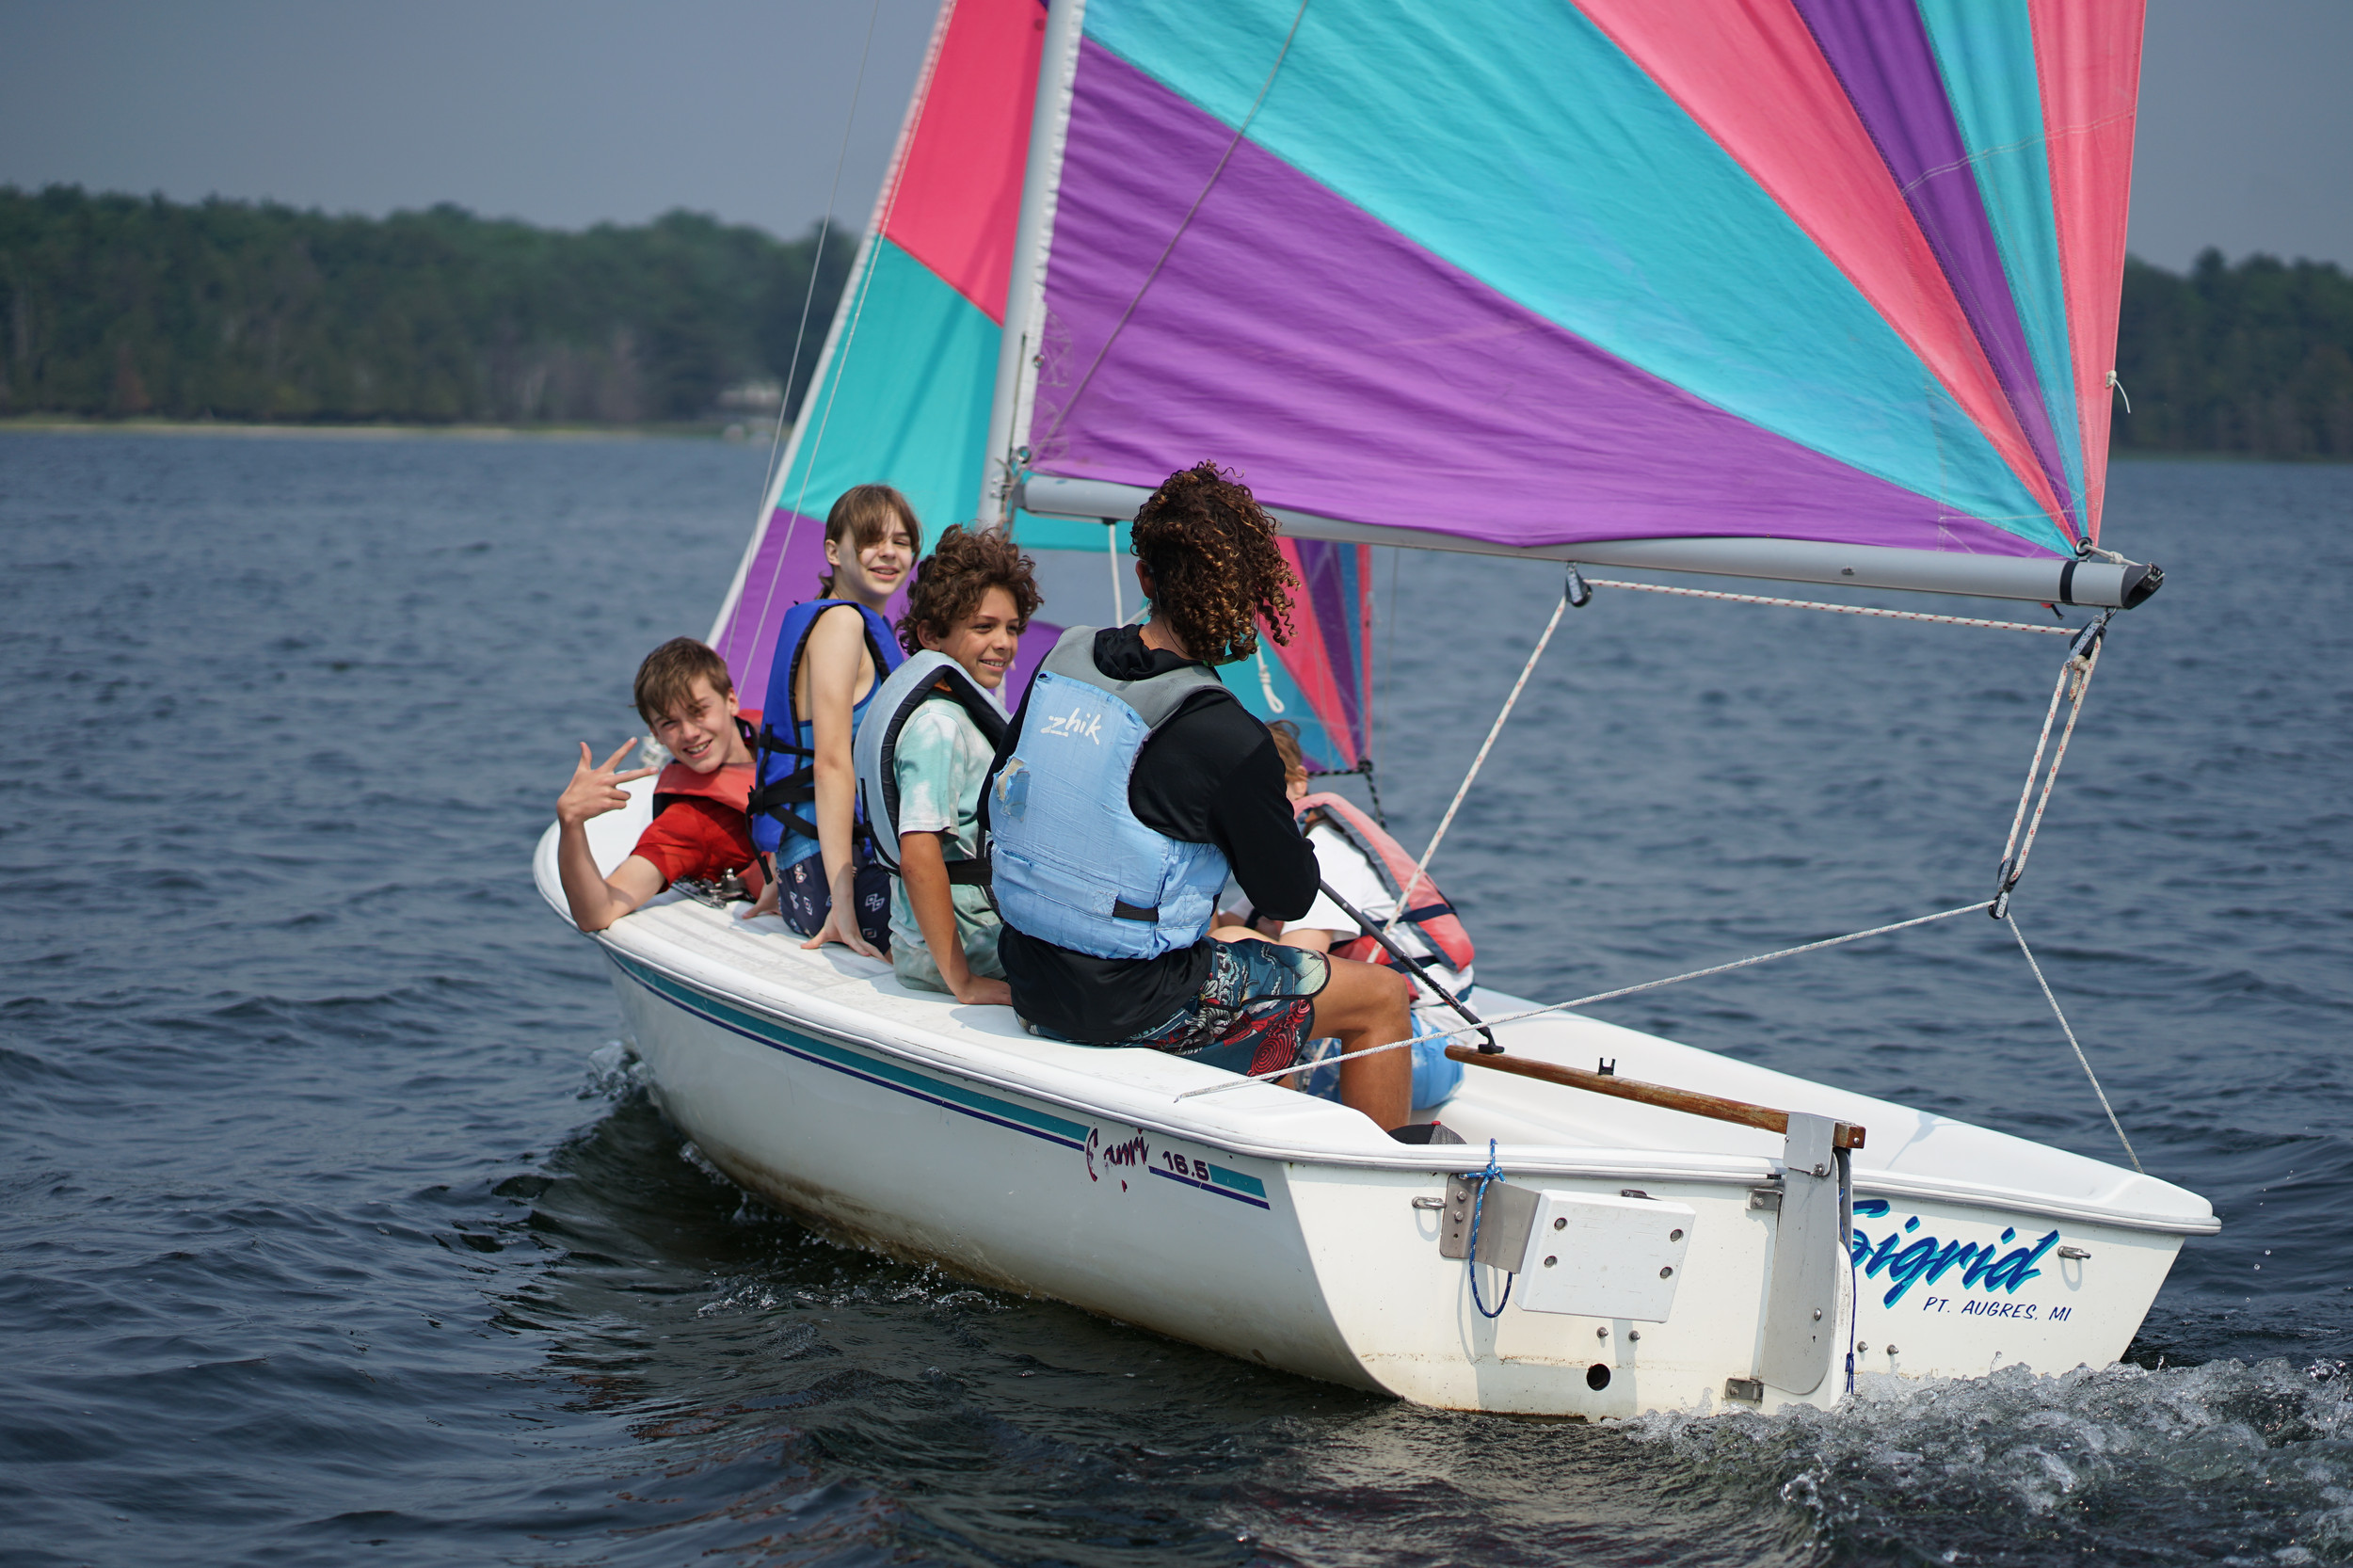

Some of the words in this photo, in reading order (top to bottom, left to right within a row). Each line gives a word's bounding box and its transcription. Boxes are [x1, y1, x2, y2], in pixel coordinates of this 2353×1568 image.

[1040, 707, 1102, 745] zhik
[1162, 1150, 1210, 1181] 16.5
[1923, 1296, 1950, 1313] PT.
[2048, 1306, 2073, 1321] MI
